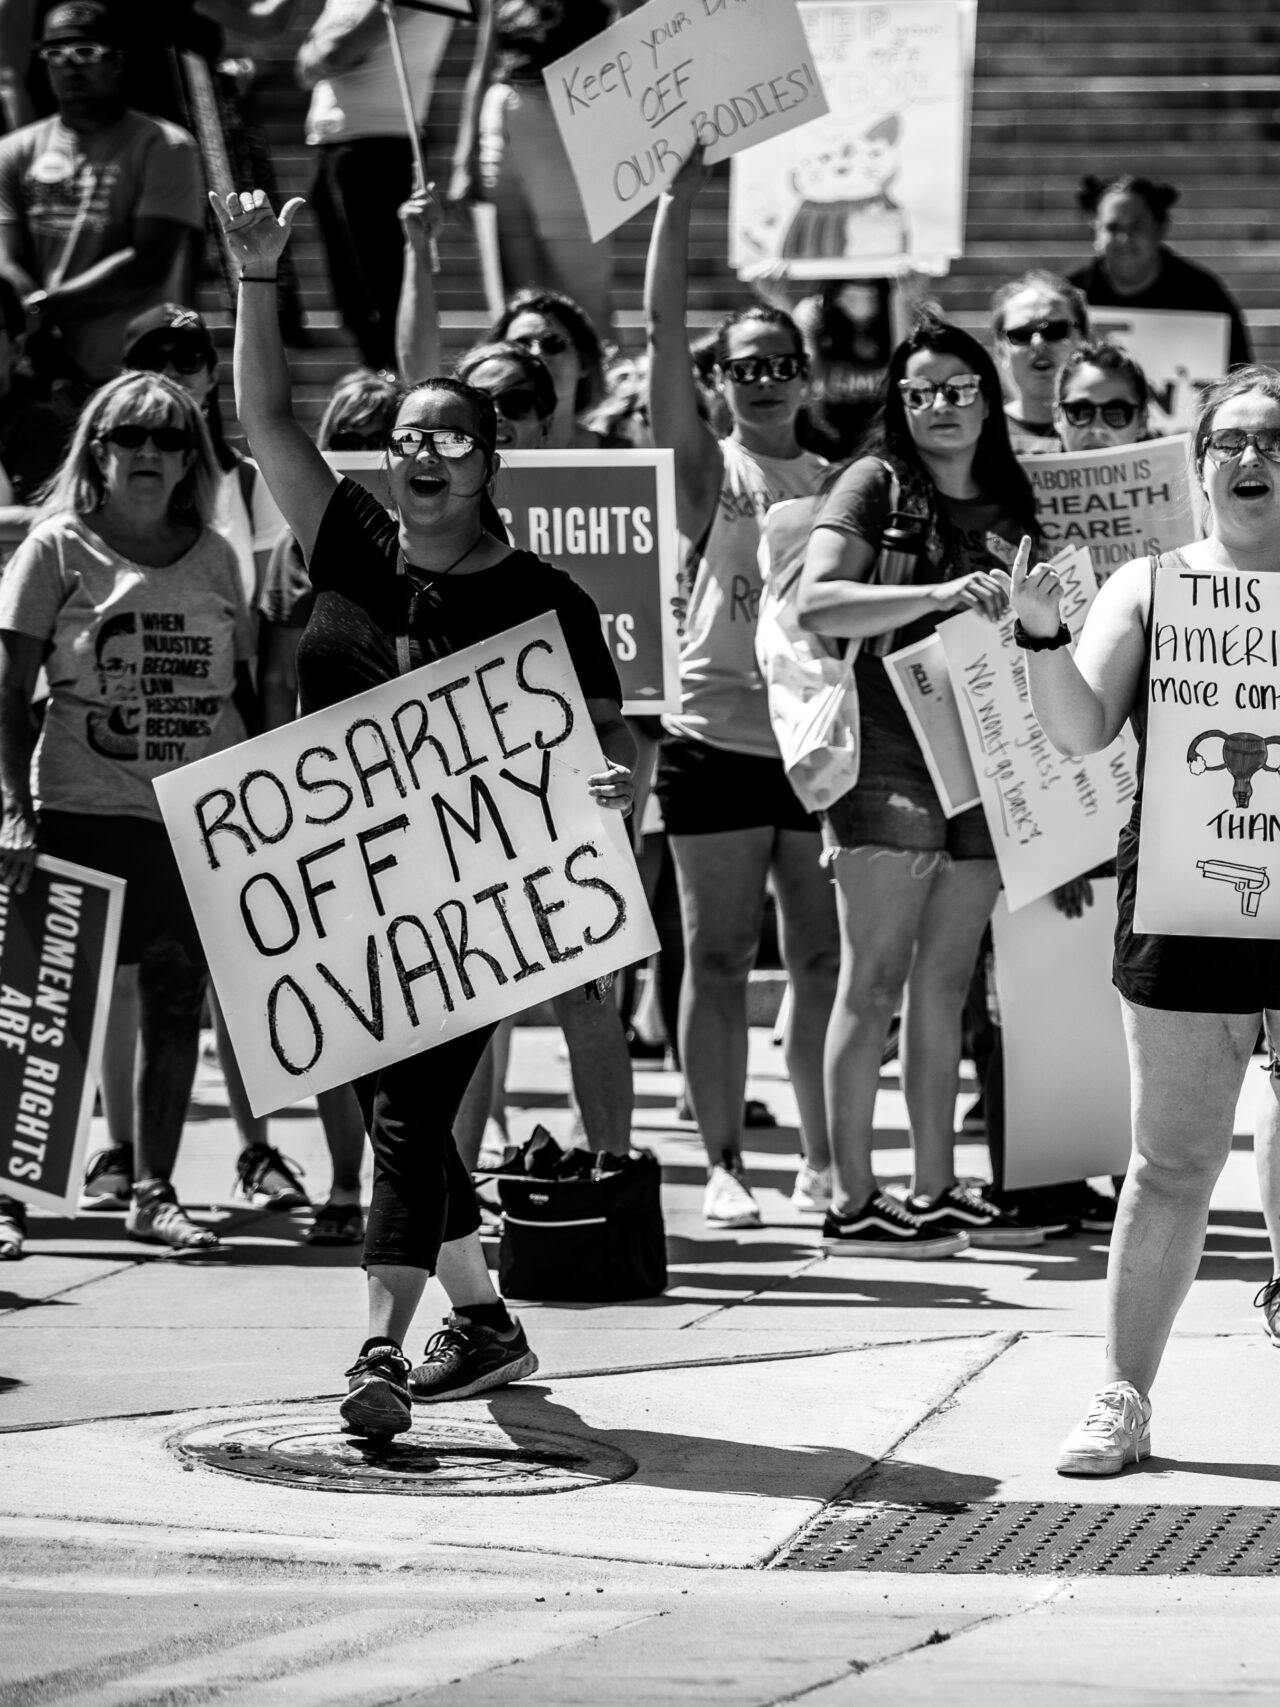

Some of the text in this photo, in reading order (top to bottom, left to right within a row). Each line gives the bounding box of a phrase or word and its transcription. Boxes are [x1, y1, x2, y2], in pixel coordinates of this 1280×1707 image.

[640, 59, 693, 123] OFF
[613, 63, 815, 202] OUR BODIES!
[1031, 459, 1152, 490] ABORTION IS
[1037, 483, 1169, 515] HEALTH
[528, 506, 654, 555] RIGHTS
[1041, 516, 1142, 540] CARE.
[1179, 574, 1261, 613] THIS
[140, 612, 185, 632] WHEN
[143, 634, 213, 656] INJUSTICE
[141, 656, 211, 679] BECOMES
[909, 662, 934, 696] ACLU
[965, 653, 996, 698] We
[140, 678, 174, 696] LAW
[1150, 676, 1219, 707] more
[145, 718, 212, 738] BECOMES
[145, 740, 190, 762] DUTY.
[193, 639, 574, 869] ROSARIES
[239, 750, 559, 957] OFF MY
[267, 842, 626, 1075] OVARIES
[8, 882, 84, 1182] WOMEN'S RIGHTS
